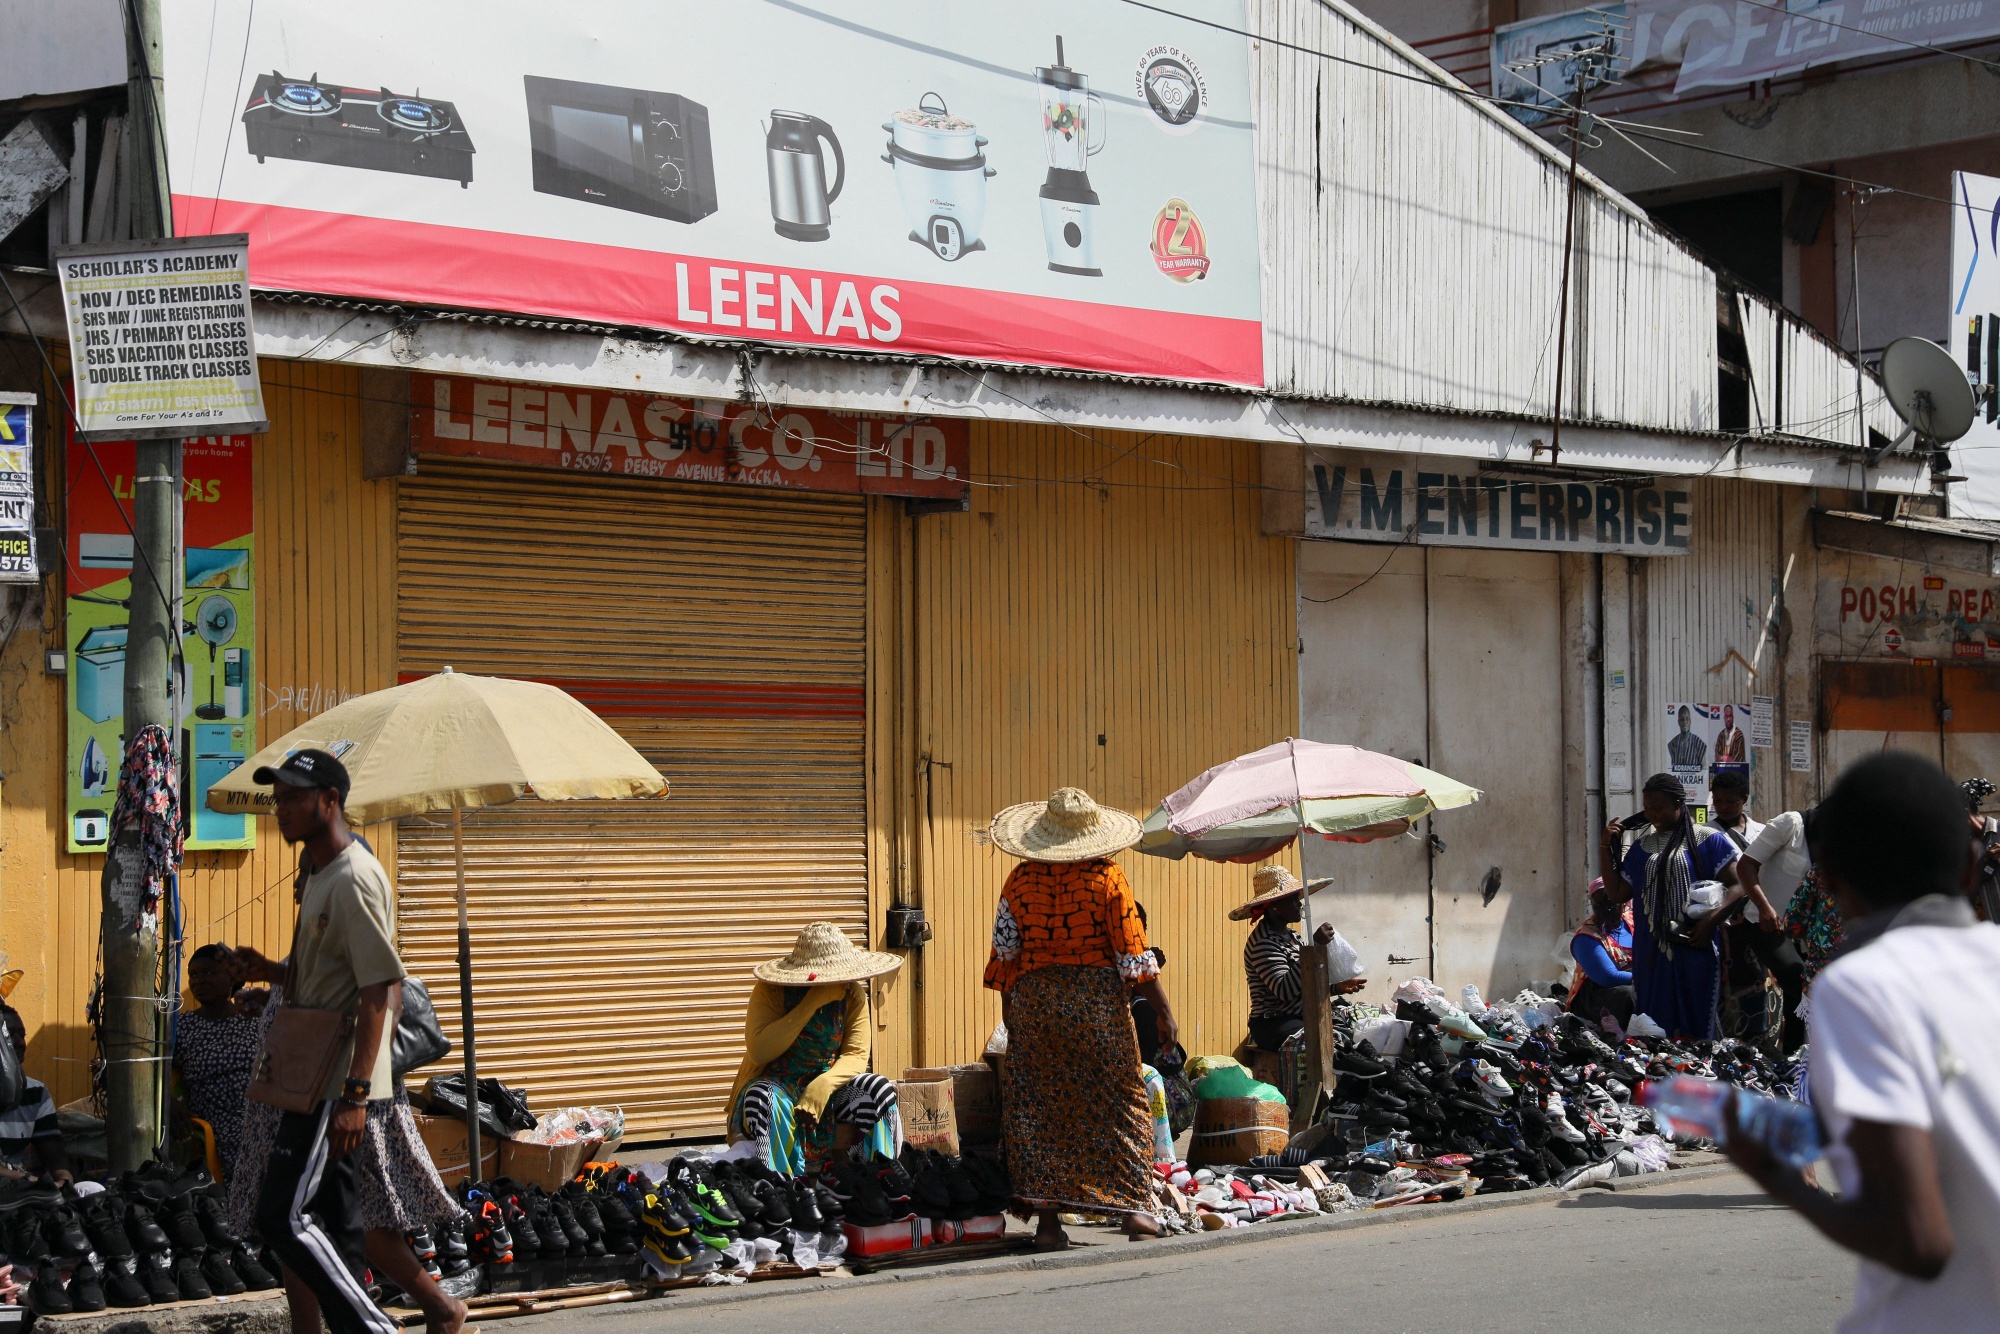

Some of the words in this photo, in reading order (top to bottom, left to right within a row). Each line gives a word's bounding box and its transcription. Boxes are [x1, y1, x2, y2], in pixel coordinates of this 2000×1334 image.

[1139, 57, 1147, 69] 60
[1145, 45, 1168, 60] YEARS
[1169, 47, 1180, 57] OF
[1135, 70, 1144, 98] OVER
[1161, 80, 1183, 106] 60
[1181, 53, 1208, 108] EXCELLENCE
[1165, 197, 1193, 256] 2
[68, 258, 158, 279] SCHOLAR'S
[162, 253, 239, 273] ACADEMY
[1160, 260, 1175, 269] YEAR
[1174, 258, 1206, 268] WARRANTY
[80, 291, 112, 309] NOV
[116, 290, 122, 307] /
[126, 288, 156, 306] DEC
[159, 283, 242, 304] REMEDIALS
[675, 262, 902, 343] LEENAS
[83, 312, 106, 327] SHS
[107, 310, 130, 326] MAY
[133, 309, 138, 324] /
[141, 308, 167, 324] JUNE
[168, 303, 245, 322] REGISTRATION
[86, 329, 111, 346] JHS
[114, 328, 119, 345] /
[122, 325, 184, 344] PRIMARY
[187, 321, 247, 341] CLASSES
[86, 347, 116, 365] SHS
[117, 343, 187, 364] VACATION
[188, 340, 249, 360] CLASSES
[89, 365, 142, 384] DOUBLE
[143, 363, 190, 381] TRACK
[191, 359, 252, 379] CLASSES
[94, 400, 117, 412] 027
[167, 397, 173, 409] /
[116, 414, 139, 422] Come
[140, 413, 156, 421] For
[158, 412, 178, 421] Your
[180, 411, 193, 419] A's
[195, 409, 211, 418] and
[434, 379, 688, 460] LEENAS
[728, 409, 823, 473] CO.
[855, 421, 958, 481] LTD.
[189, 447, 208, 457] your
[210, 447, 234, 458] home
[234, 439, 246, 448] UK
[573, 453, 613, 472] 509/3
[623, 458, 668, 476] DERBY
[674, 463, 726, 480] AVENUE
[1417, 471, 1690, 548] ENTERPRISE
[1840, 585, 1917, 624] POSH
[1677, 774, 1704, 785] NKRAH
[226, 791, 251, 805] MTN
[1698, 813, 1704, 823] 6
